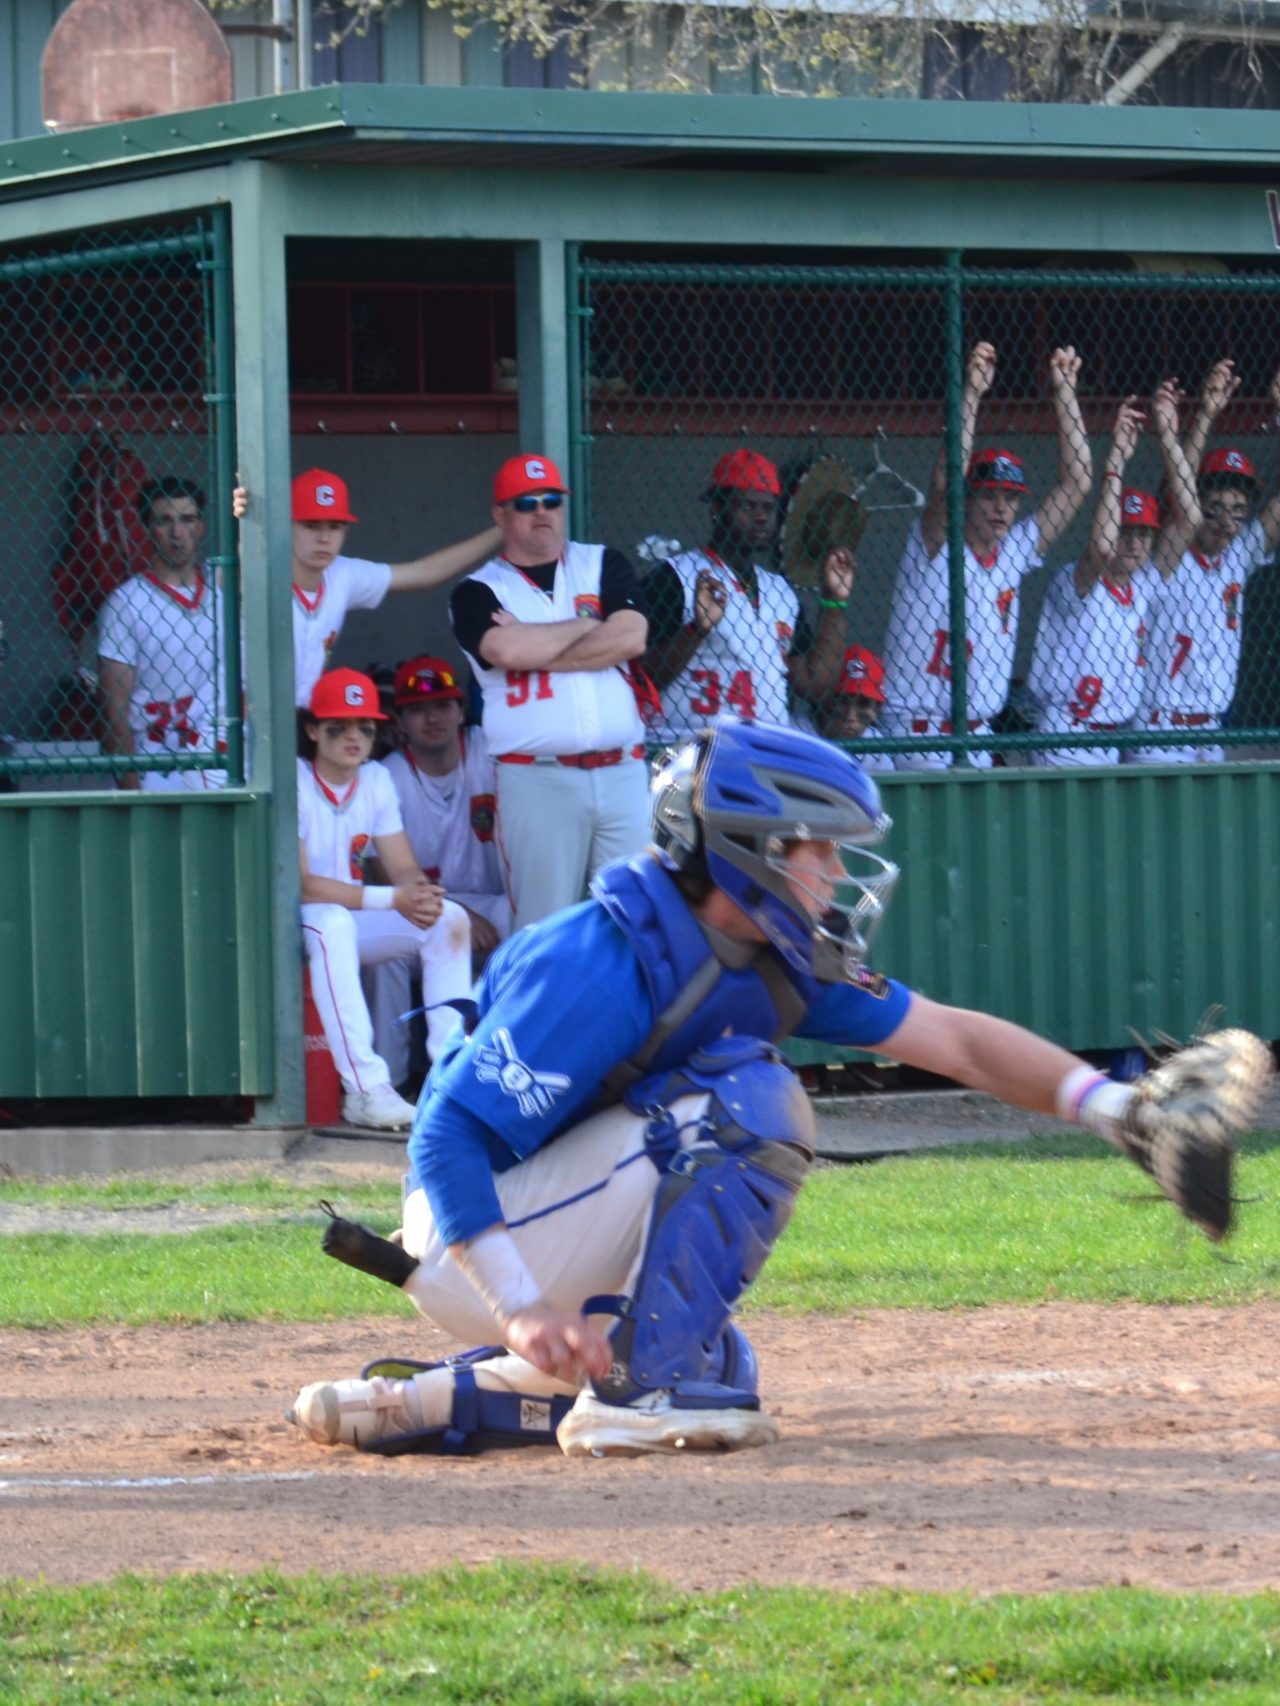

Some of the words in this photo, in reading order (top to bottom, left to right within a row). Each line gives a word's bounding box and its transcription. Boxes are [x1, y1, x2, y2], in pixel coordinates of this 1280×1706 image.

[525, 460, 546, 480] C
[315, 485, 336, 507] C
[1170, 633, 1193, 680] 7
[344, 684, 365, 706] C
[690, 670, 757, 720] 34
[1069, 675, 1103, 719] 9
